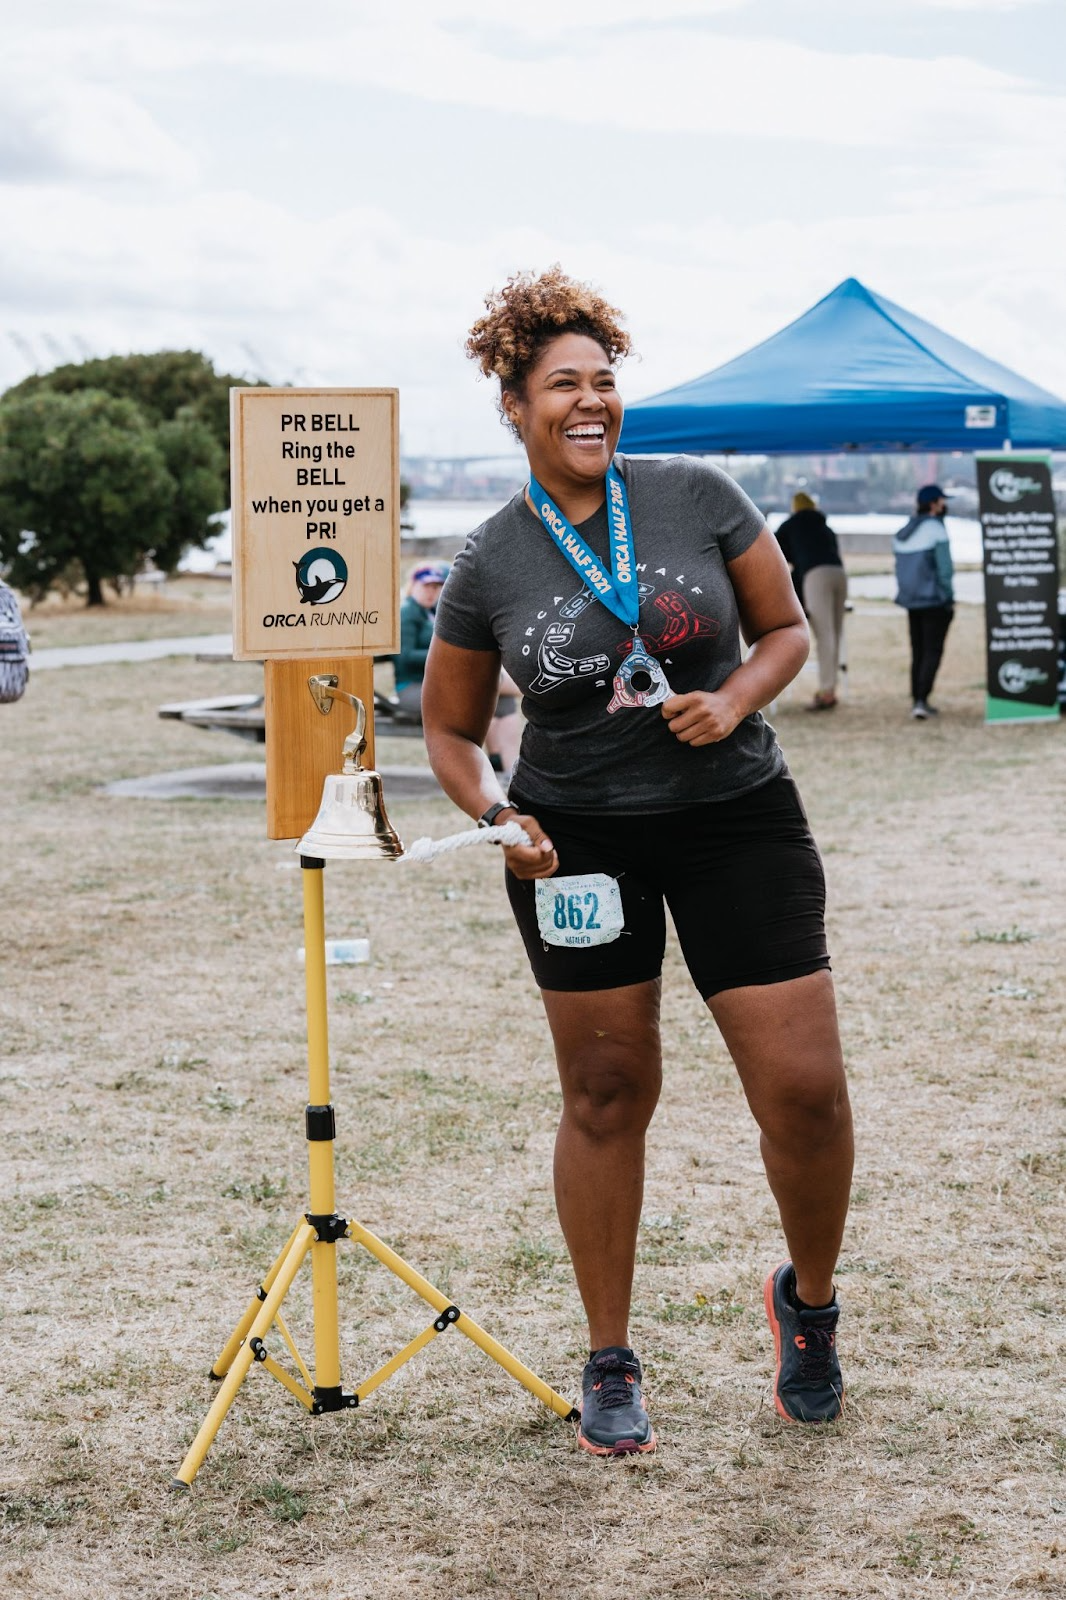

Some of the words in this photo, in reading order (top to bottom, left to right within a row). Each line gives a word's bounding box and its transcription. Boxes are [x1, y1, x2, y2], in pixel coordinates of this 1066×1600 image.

[281, 414, 306, 432] PR
[311, 414, 360, 432] BELL
[282, 441, 322, 463] Ring
[326, 441, 355, 458] the
[296, 468, 346, 486] BELL
[609, 478, 624, 507] 2021
[252, 496, 302, 514] when
[306, 498, 338, 517] you
[342, 495, 370, 516] get
[374, 498, 385, 511] a
[306, 521, 337, 539] PR!
[613, 507, 629, 542] HALF
[541, 503, 566, 540] ORCA
[562, 533, 593, 567] HALF
[584, 564, 612, 594] 2021
[615, 543, 632, 583] ORCA
[262, 613, 307, 628] ORCA
[310, 610, 379, 626] RUNNING
[521, 596, 564, 656] ORCA
[635, 563, 703, 596] HALF
[553, 892, 601, 930] 862
